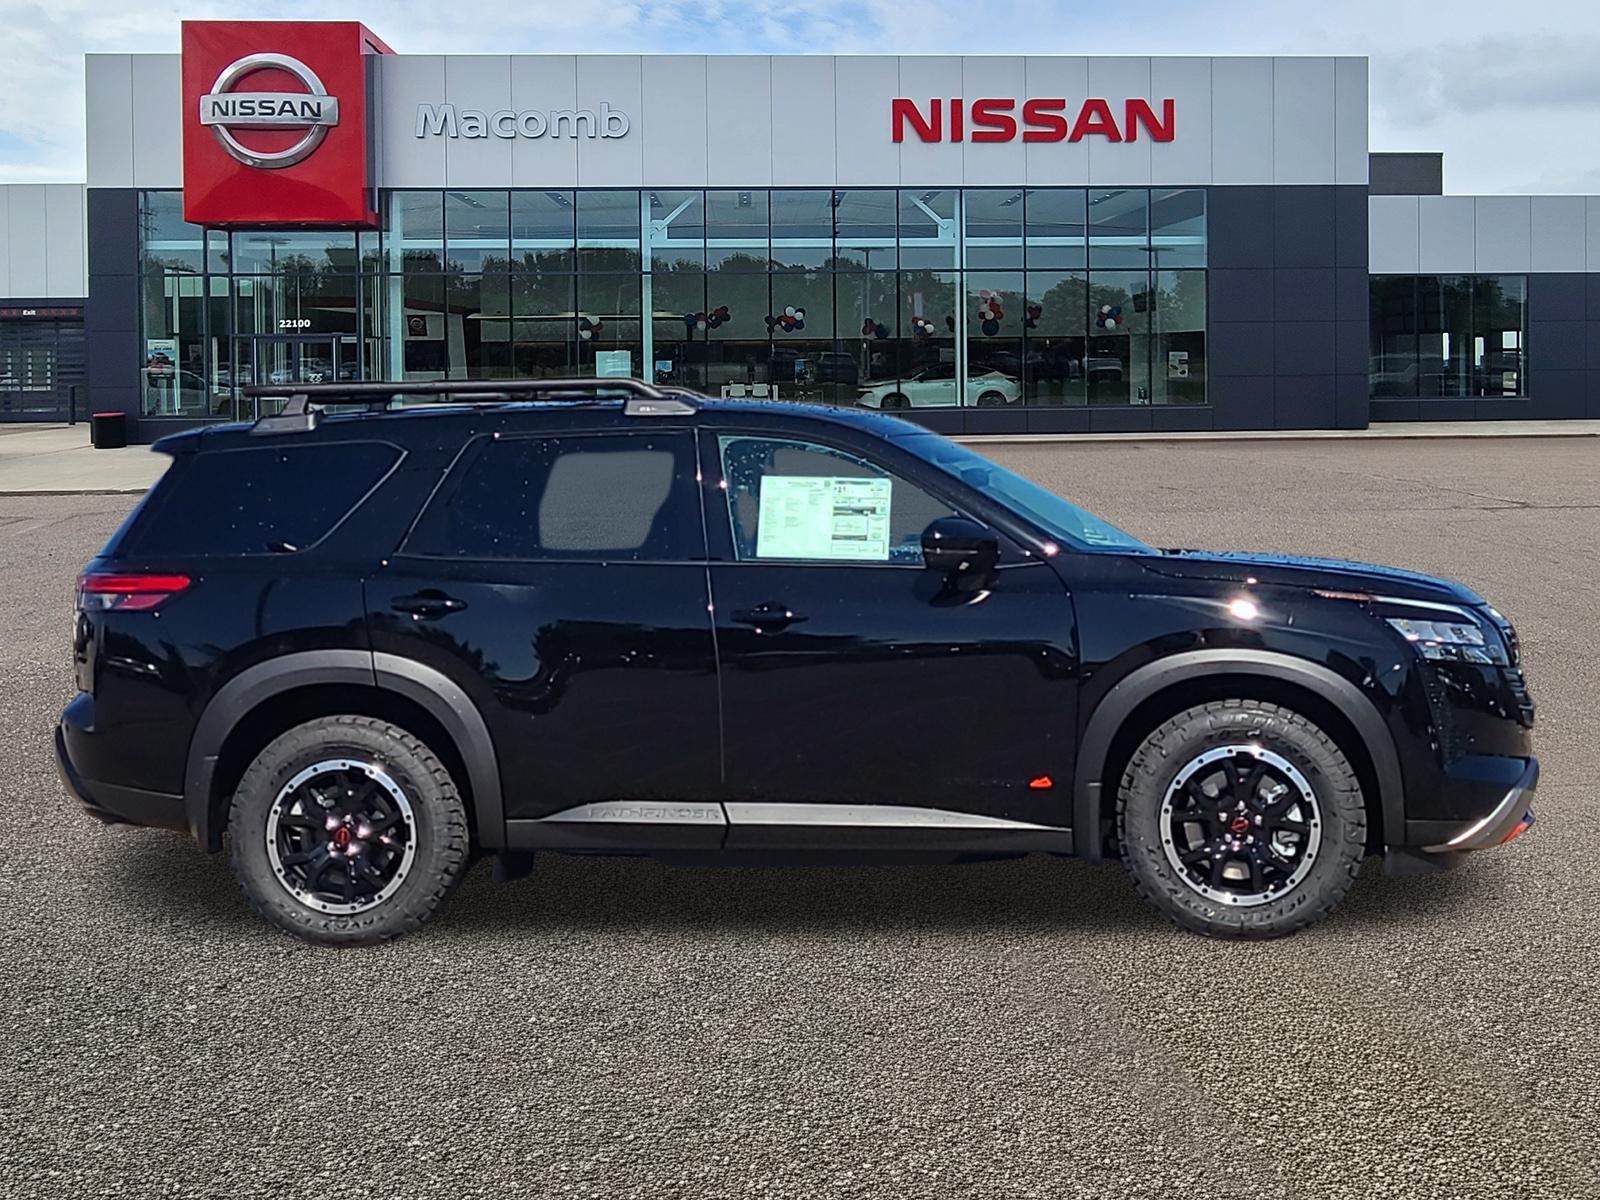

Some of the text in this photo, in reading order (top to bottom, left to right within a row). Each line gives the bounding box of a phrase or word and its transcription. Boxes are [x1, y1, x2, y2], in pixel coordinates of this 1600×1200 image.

[207, 100, 322, 118] NISSAN
[415, 102, 630, 139] Macomb
[892, 98, 1175, 142] NISSAN
[279, 319, 311, 328] 22100
[588, 807, 720, 820] PATHFINDER
